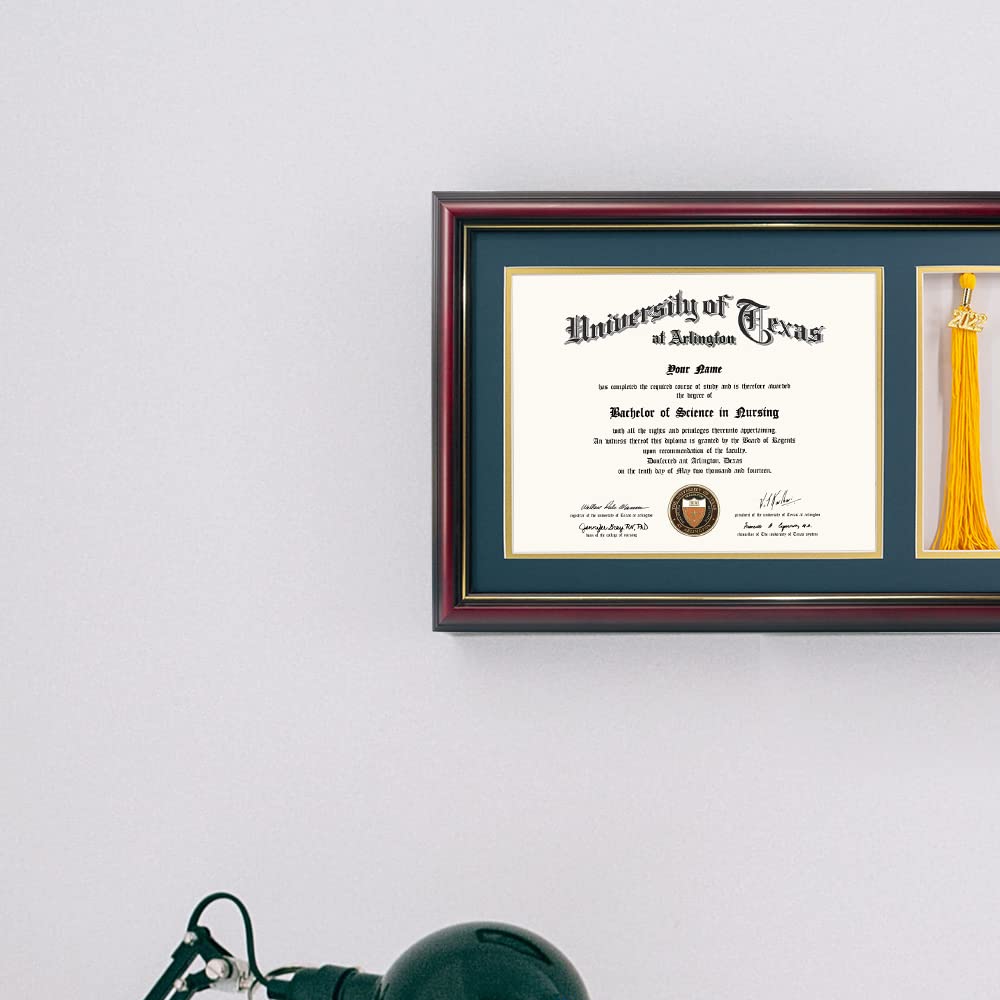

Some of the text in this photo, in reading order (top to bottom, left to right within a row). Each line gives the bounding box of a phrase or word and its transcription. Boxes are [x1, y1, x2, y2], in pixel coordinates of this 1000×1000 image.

[564, 289, 826, 346] University of Texas
[652, 329, 736, 348] at Arlington
[666, 364, 723, 375] Your Name
[610, 406, 779, 419] Bachelor of Science in Nursing
